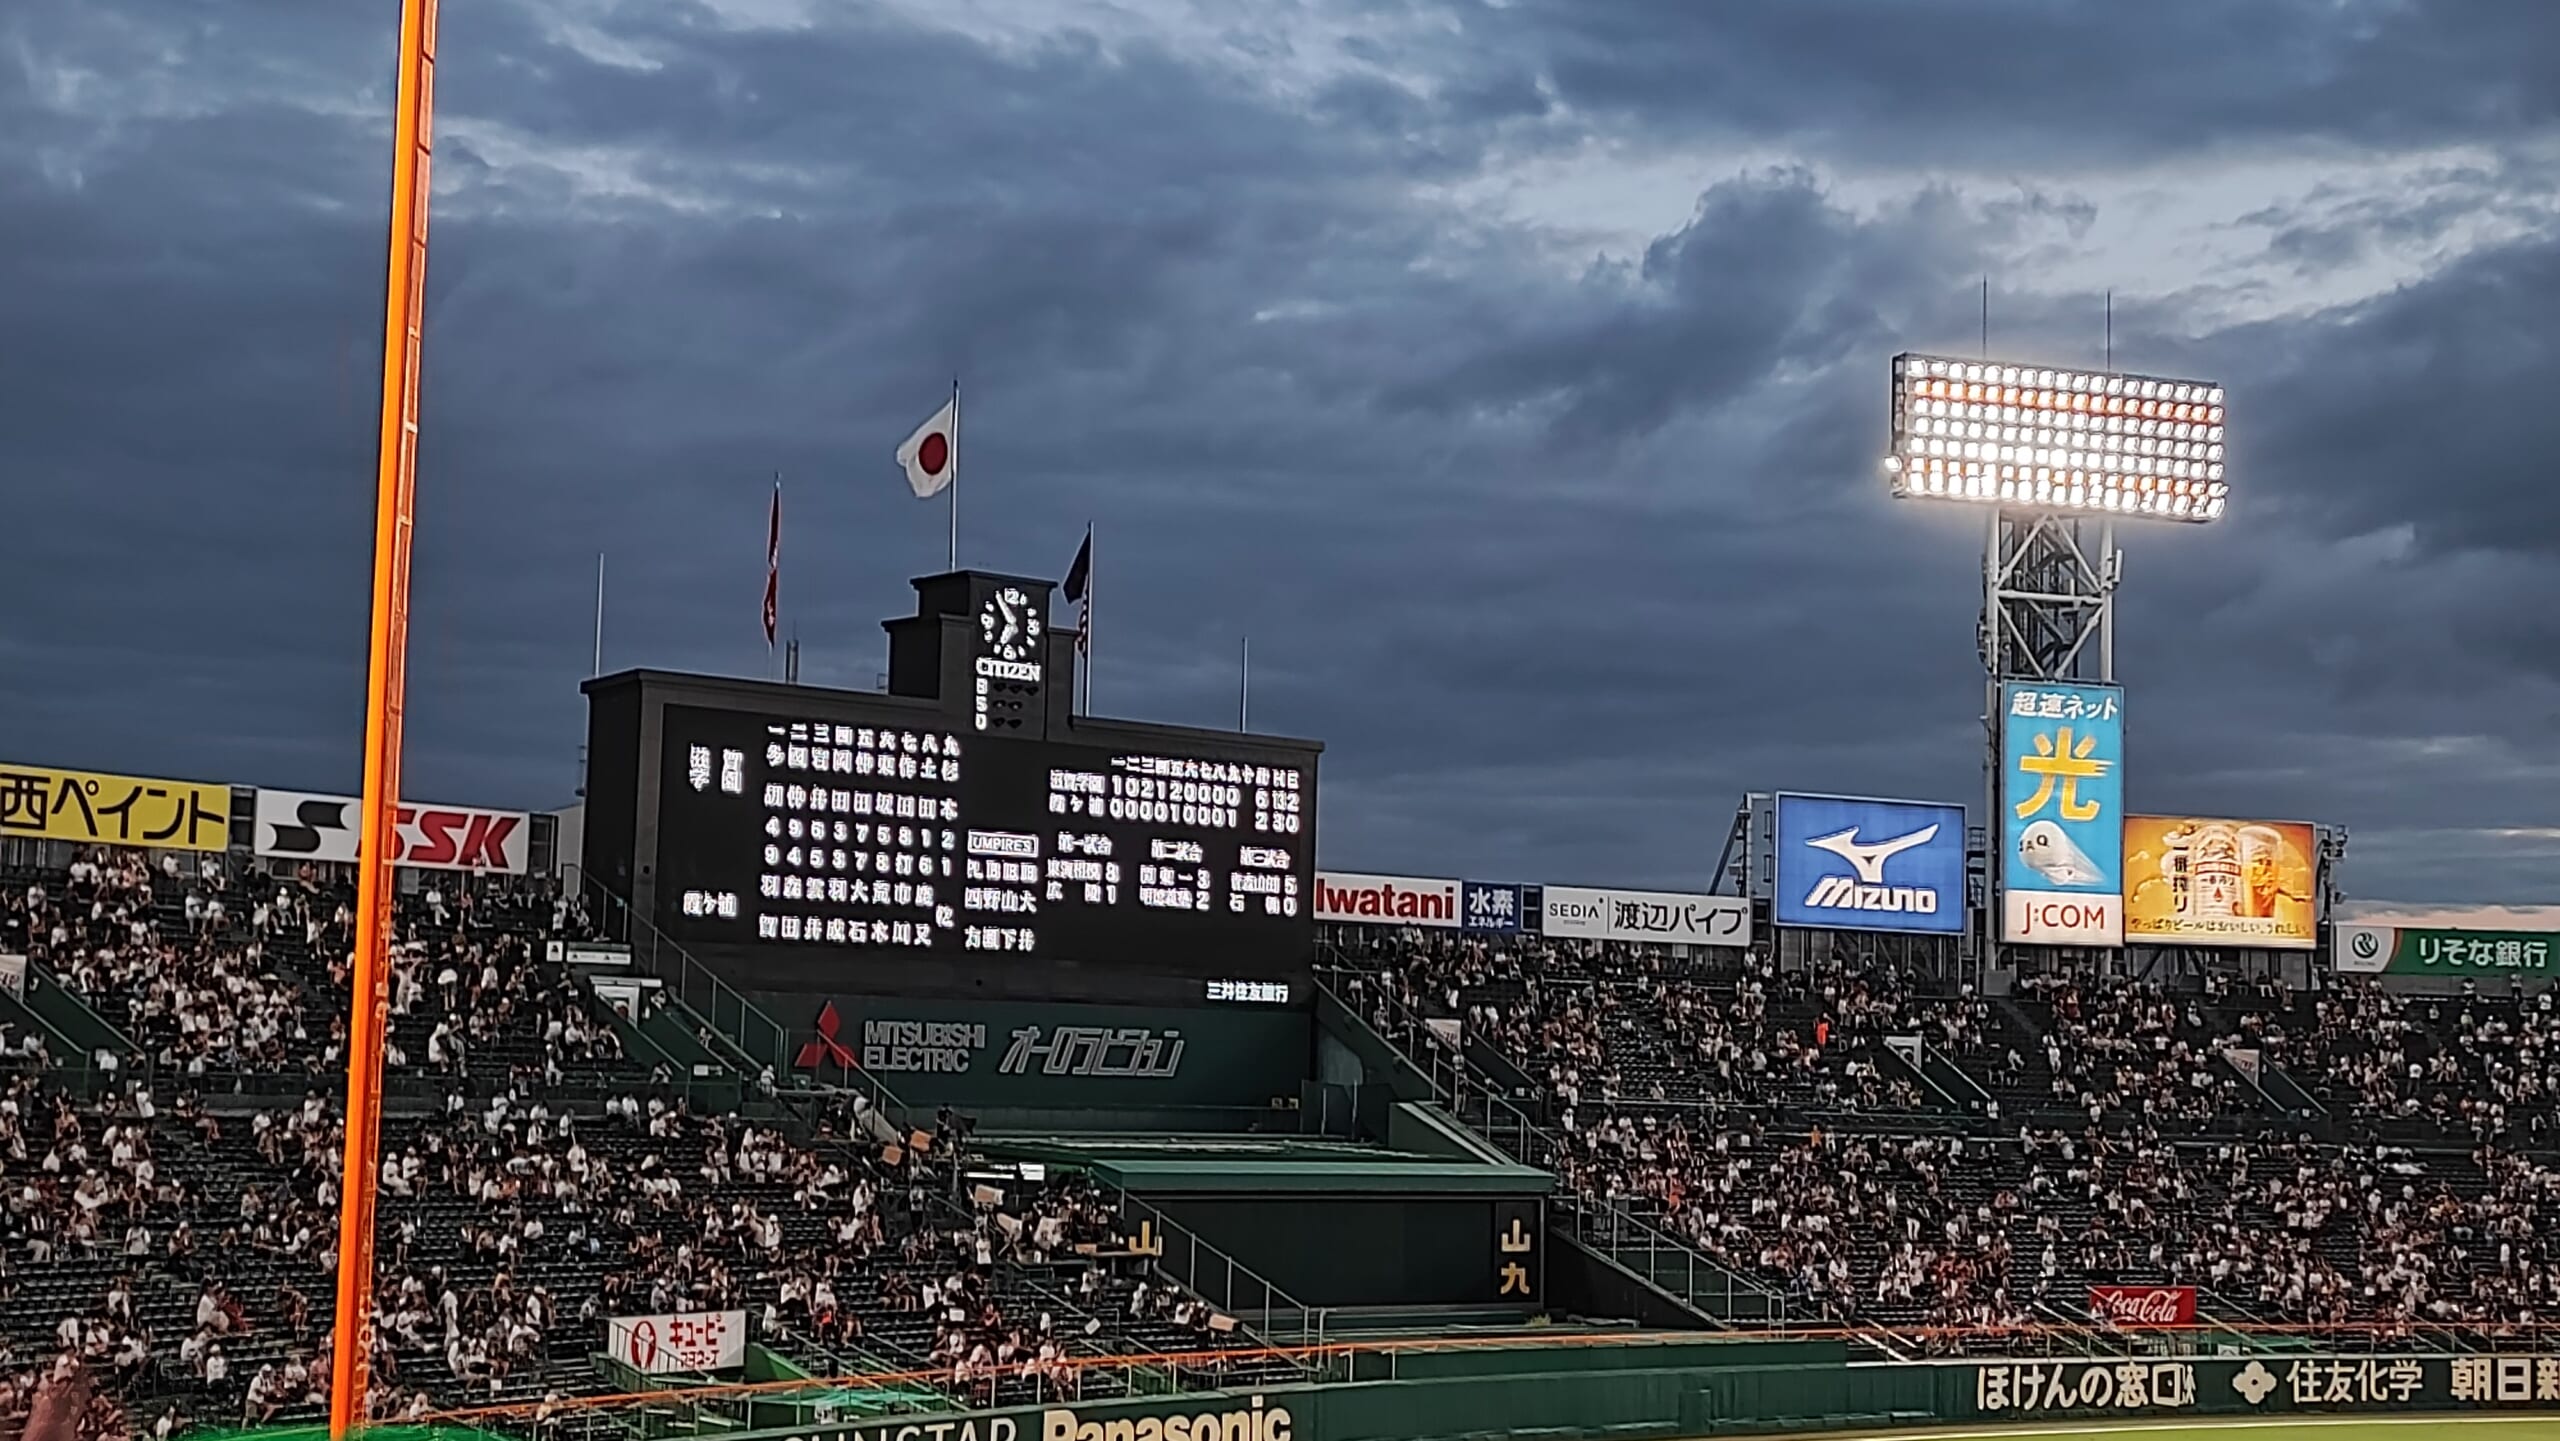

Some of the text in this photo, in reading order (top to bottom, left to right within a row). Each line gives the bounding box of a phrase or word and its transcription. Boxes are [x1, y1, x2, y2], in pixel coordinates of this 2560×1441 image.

[976, 657, 1041, 682] CITIZEN
[2011, 691, 2117, 720] 超速ネット
[2015, 726, 2115, 821] 光
[0, 773, 225, 844] 西ペイント
[972, 835, 1032, 853] UMPIRES
[1315, 878, 1454, 920] Iwatani
[1468, 887, 1514, 916] 水素
[1549, 903, 1599, 918] SEDIA
[1614, 899, 1748, 935] 渡辺パイプ
[2021, 902, 2104, 935] J:COM
[2420, 937, 2548, 968] りそな銀行
[865, 1020, 986, 1048] MITSUBISHI
[864, 1046, 969, 1072] ELECTRIC
[1501, 1219, 1530, 1294] 山九
[669, 1314, 725, 1349] キューピー
[2286, 1359, 2423, 1403] 住友化学
